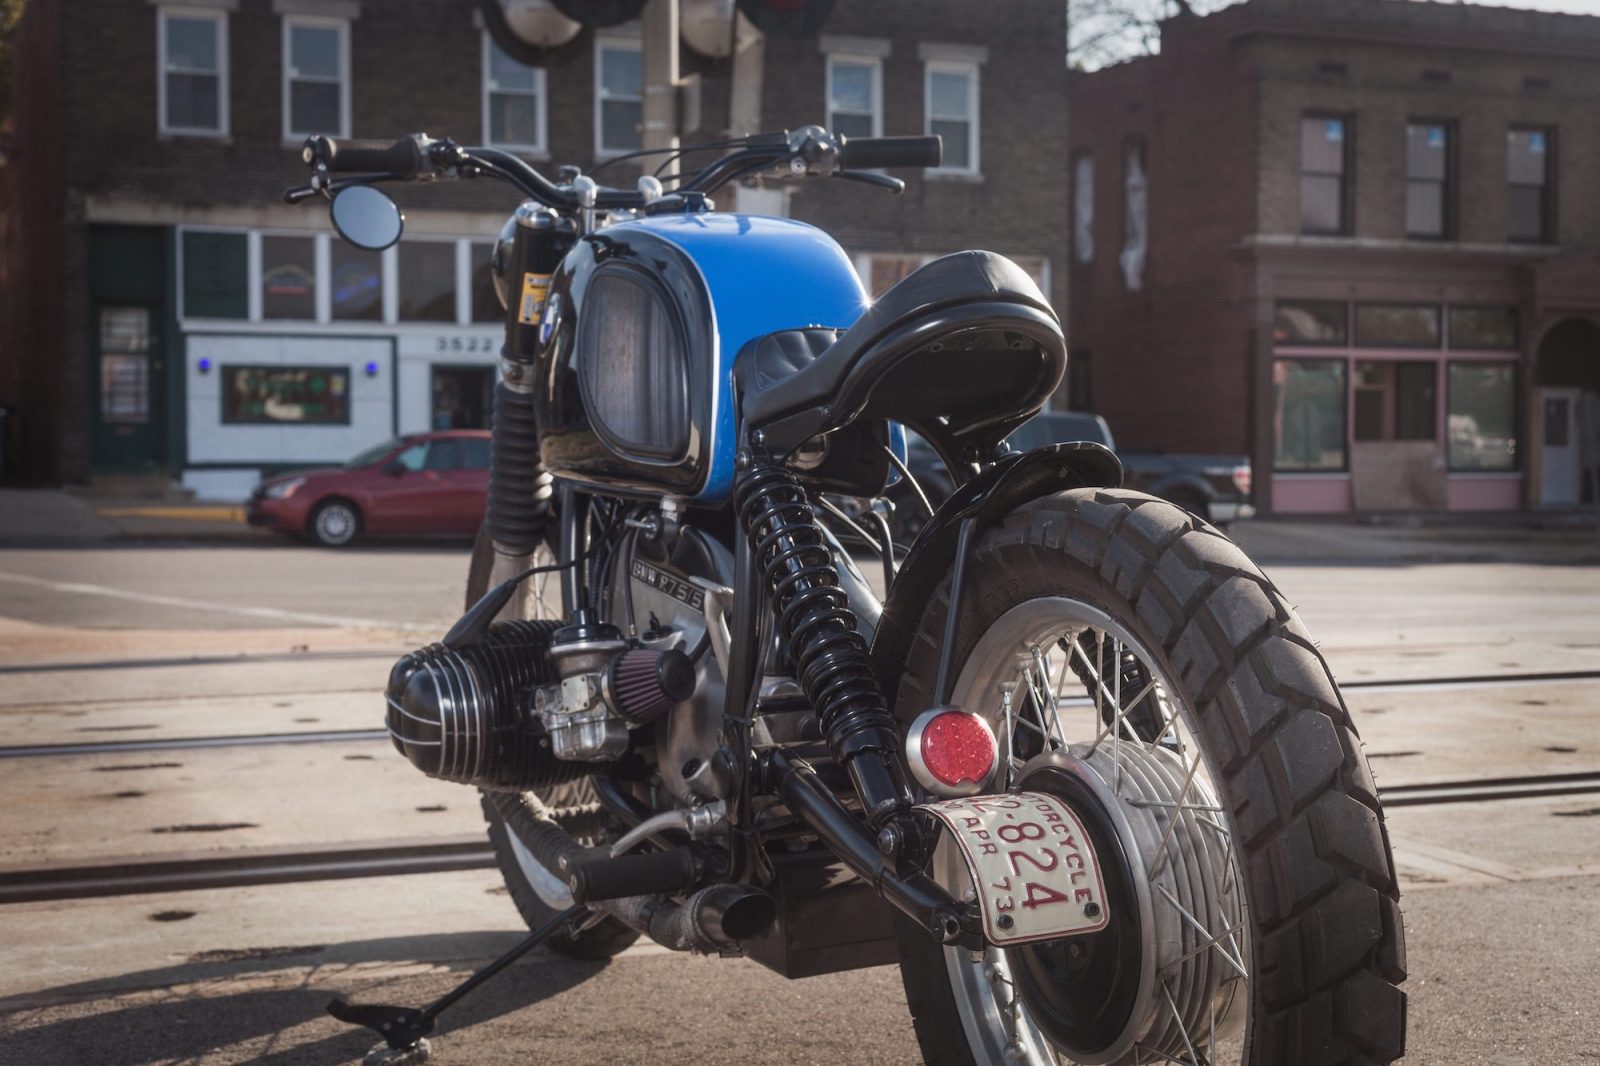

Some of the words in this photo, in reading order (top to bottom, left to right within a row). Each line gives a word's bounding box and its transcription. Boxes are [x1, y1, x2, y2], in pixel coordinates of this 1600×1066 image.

[632, 561, 658, 586] BMW
[659, 574, 704, 609] R75/5
[961, 816, 998, 856] APR
[991, 876, 1015, 913] 73
[1021, 793, 1093, 904] OTORCYCLE
